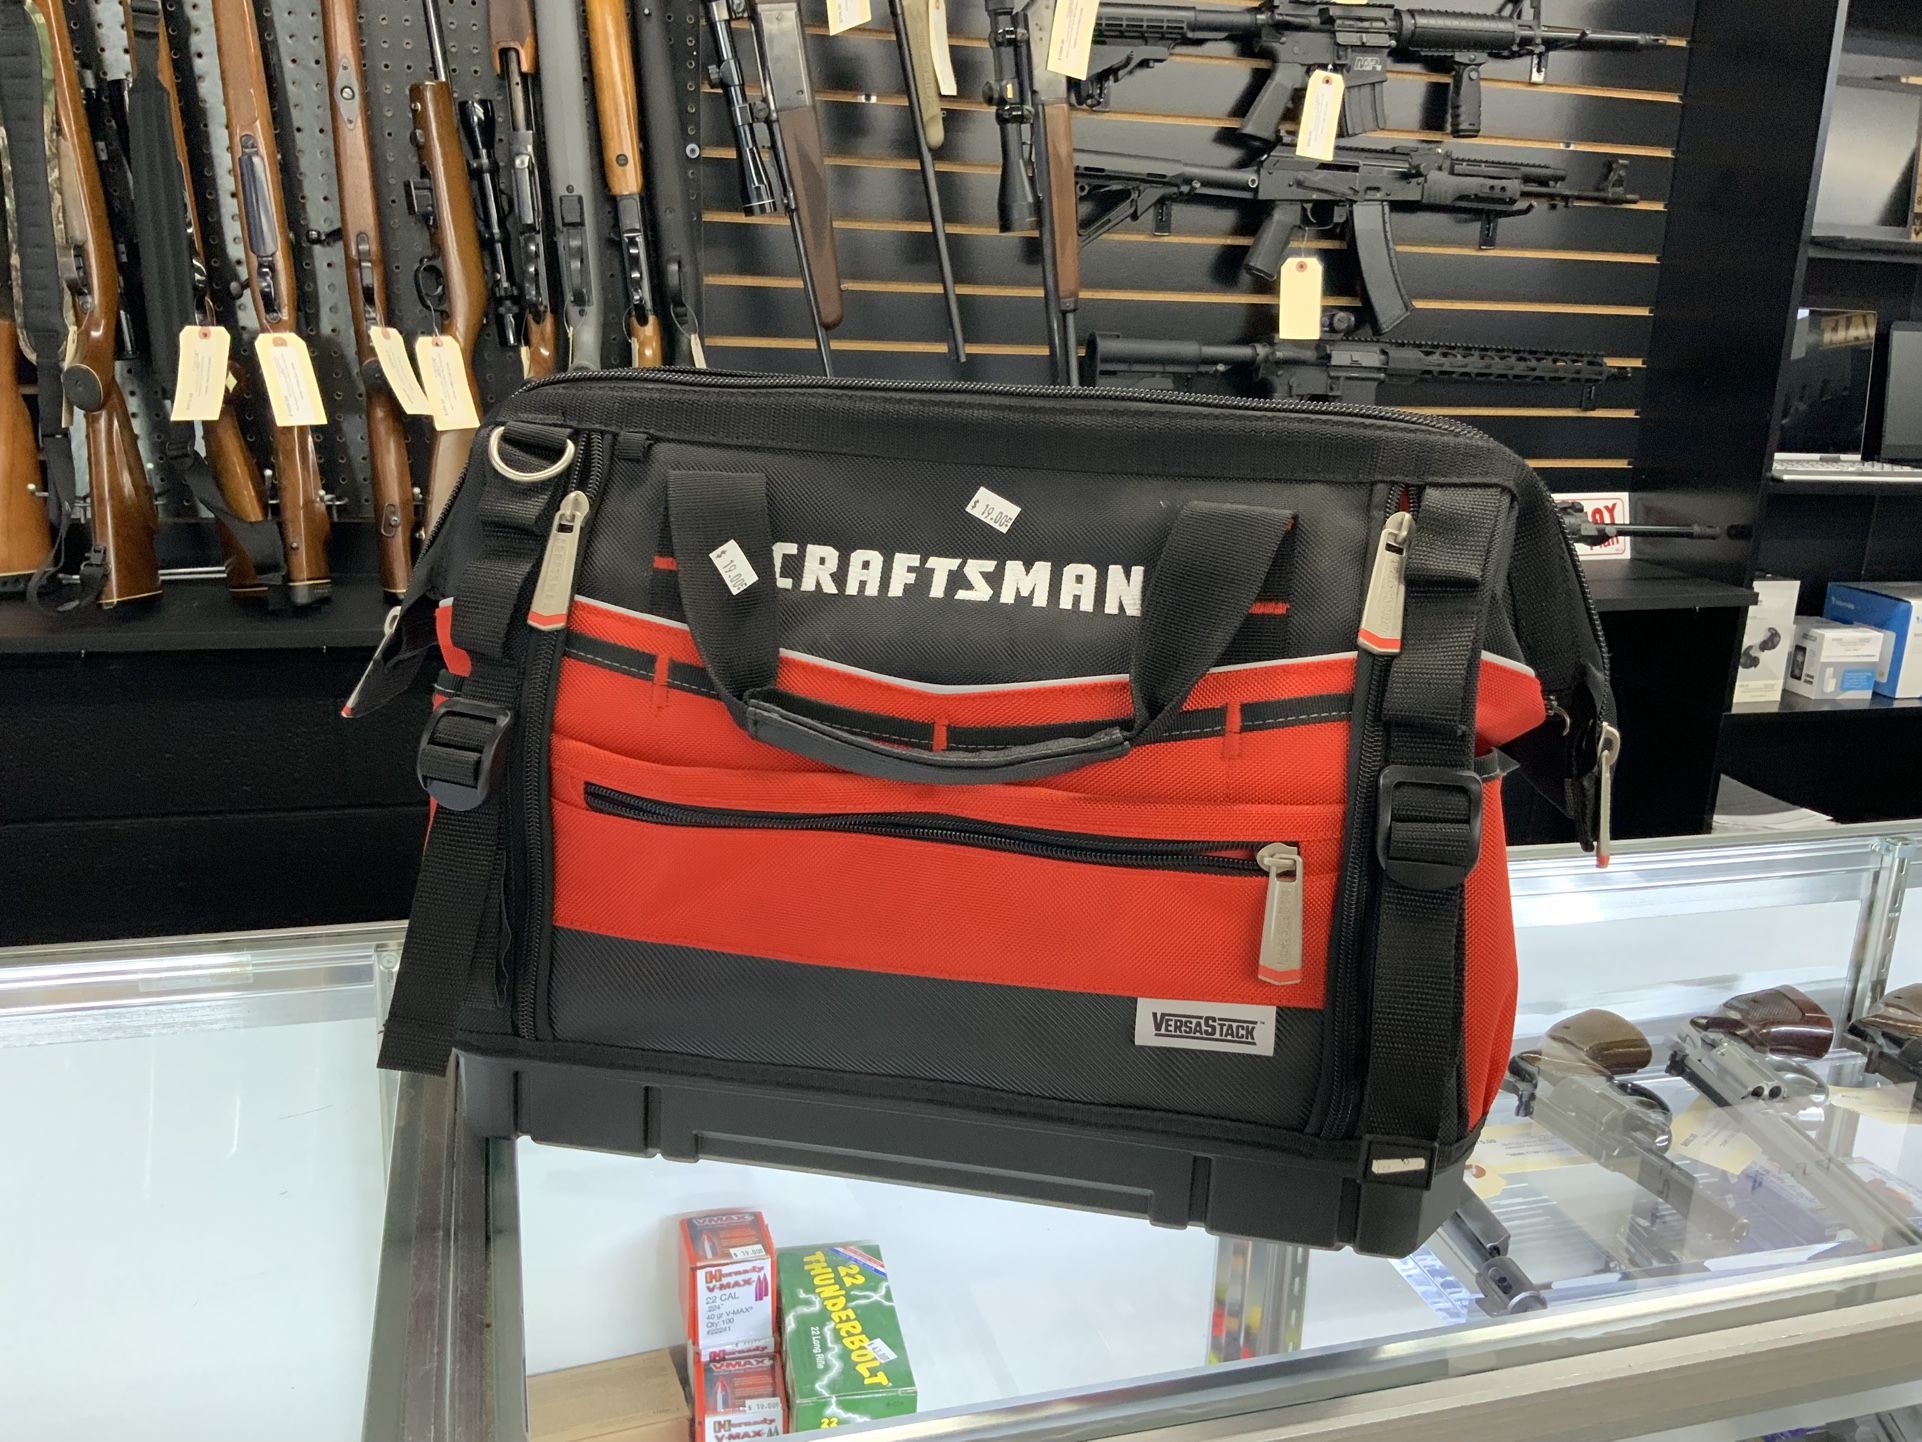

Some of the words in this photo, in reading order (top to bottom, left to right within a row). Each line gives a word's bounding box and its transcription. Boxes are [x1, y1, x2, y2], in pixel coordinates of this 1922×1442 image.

[771, 542, 1144, 616] CRAFTSMAN
[705, 1265, 764, 1284] Hornady
[838, 1264, 865, 1287] 22
[706, 1278, 752, 1292] V-MAX
[706, 1296, 717, 1304] 22
[719, 1292, 740, 1301] CAL
[722, 1317, 735, 1325] 100
[803, 1251, 889, 1386] THUNDERBOLT
[811, 1326, 820, 1335] 22
[711, 1358, 769, 1371] V-MAX
[713, 1418, 776, 1433] Hornady
[820, 1418, 838, 1428] 22
